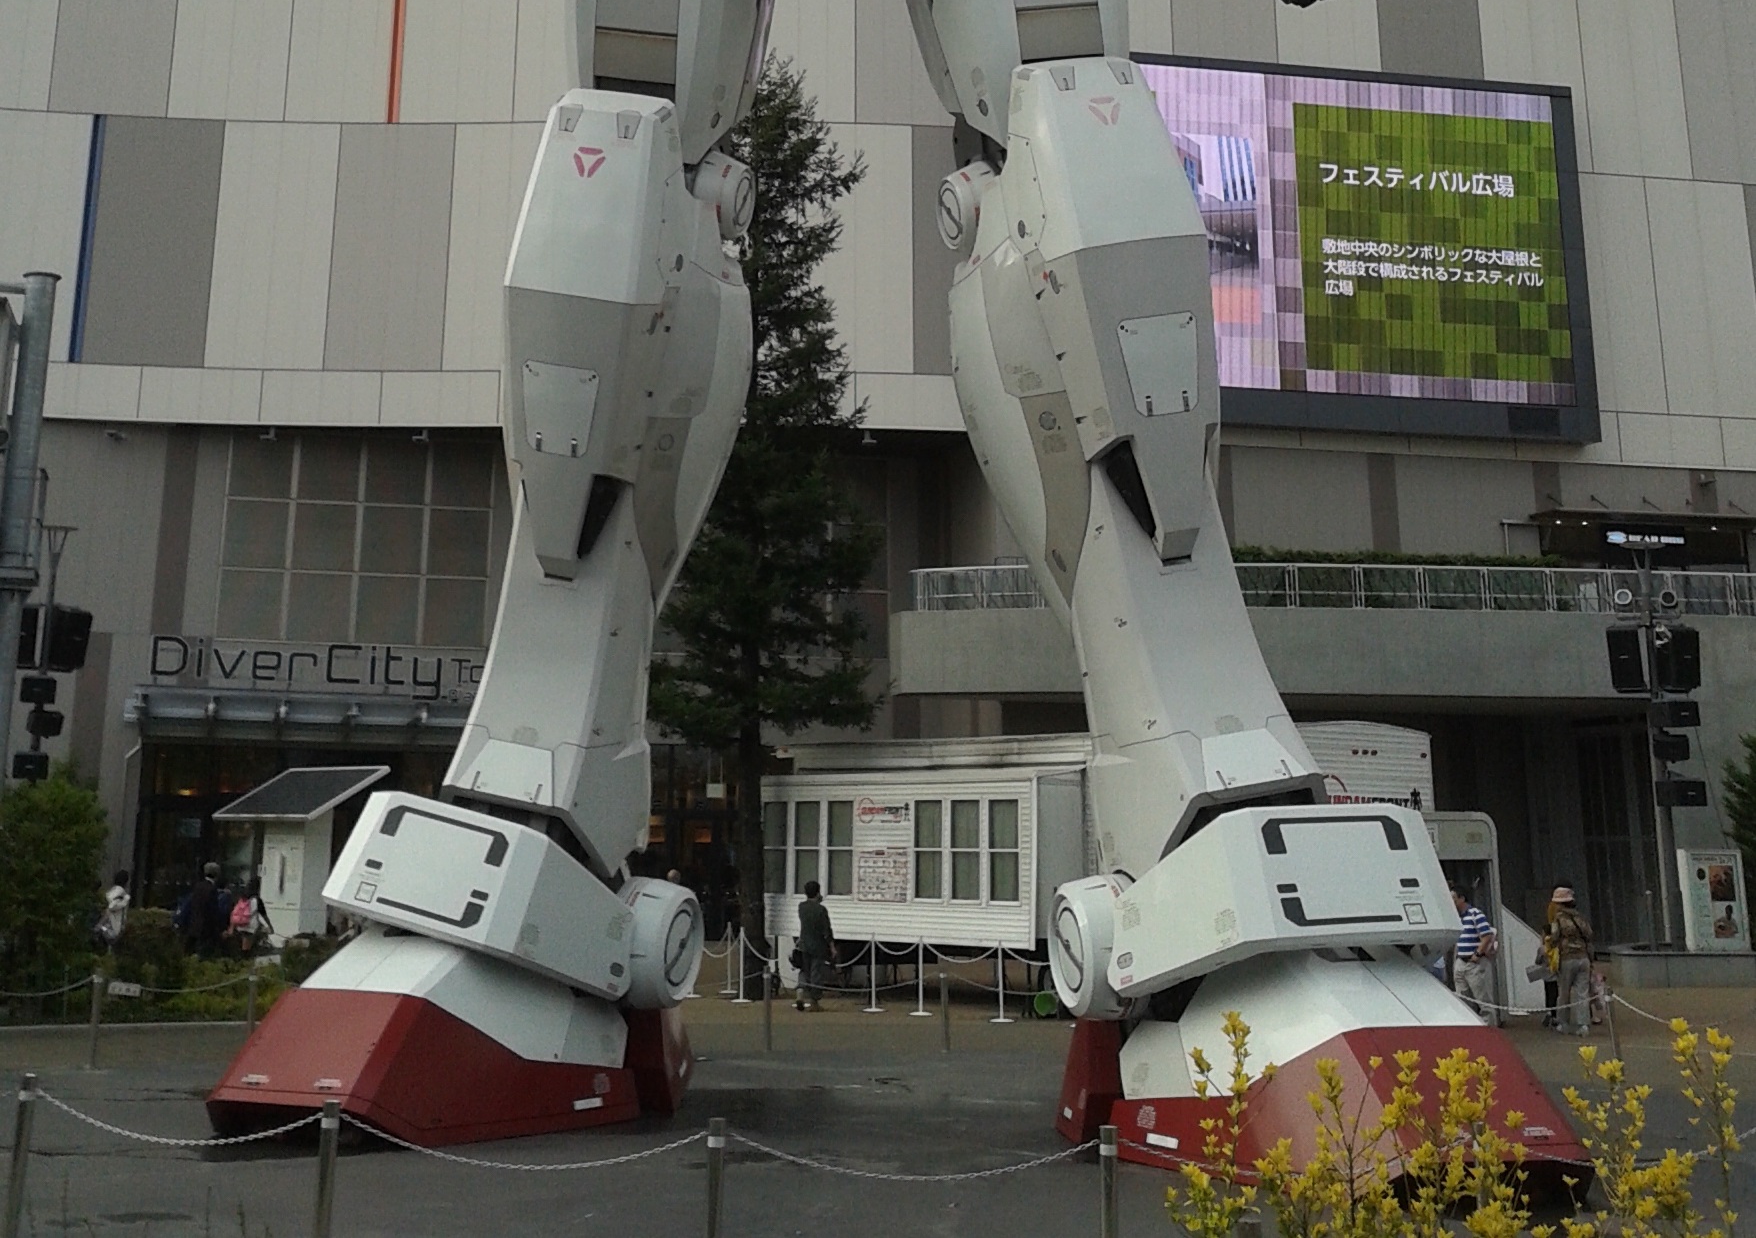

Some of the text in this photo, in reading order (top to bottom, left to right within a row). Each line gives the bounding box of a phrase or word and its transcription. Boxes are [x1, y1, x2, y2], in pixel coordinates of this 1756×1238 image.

[1318, 163, 1515, 198] フェスティバル広場
[1323, 258, 1544, 287] 大階段で構成されるフェスティバル
[1325, 279, 1354, 297] 広場
[150, 635, 442, 700] DiverCity
